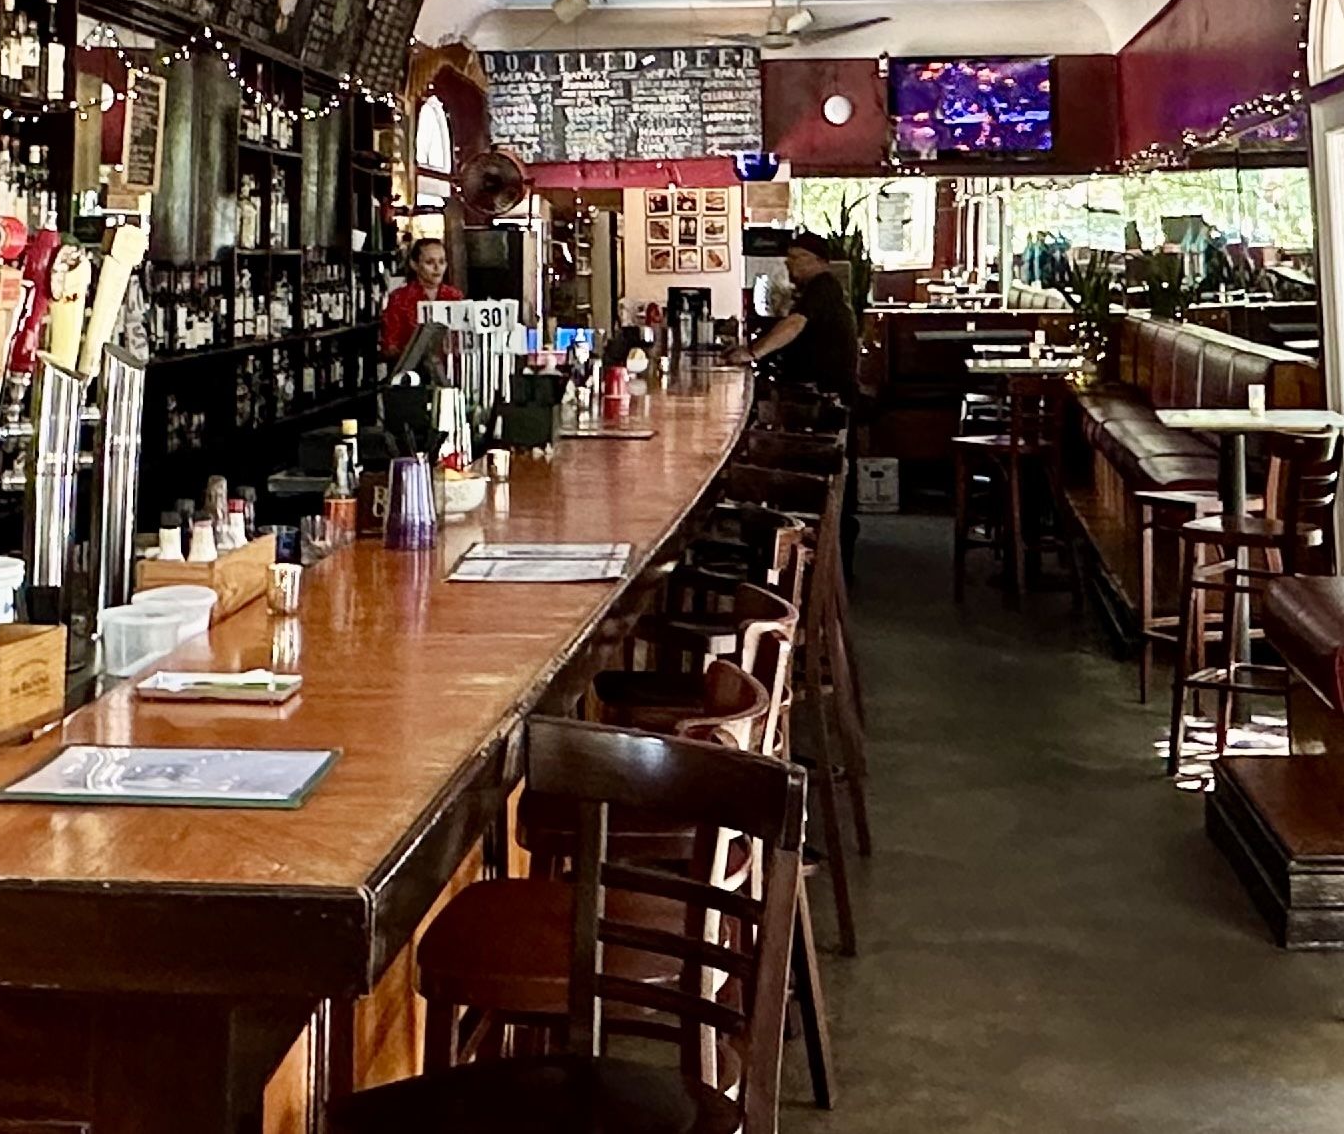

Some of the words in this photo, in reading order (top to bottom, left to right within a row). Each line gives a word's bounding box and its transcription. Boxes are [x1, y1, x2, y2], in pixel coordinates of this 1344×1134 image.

[484, 51, 637, 73] BOTTLED
[673, 48, 756, 69] BEER
[480, 307, 502, 328] 30
